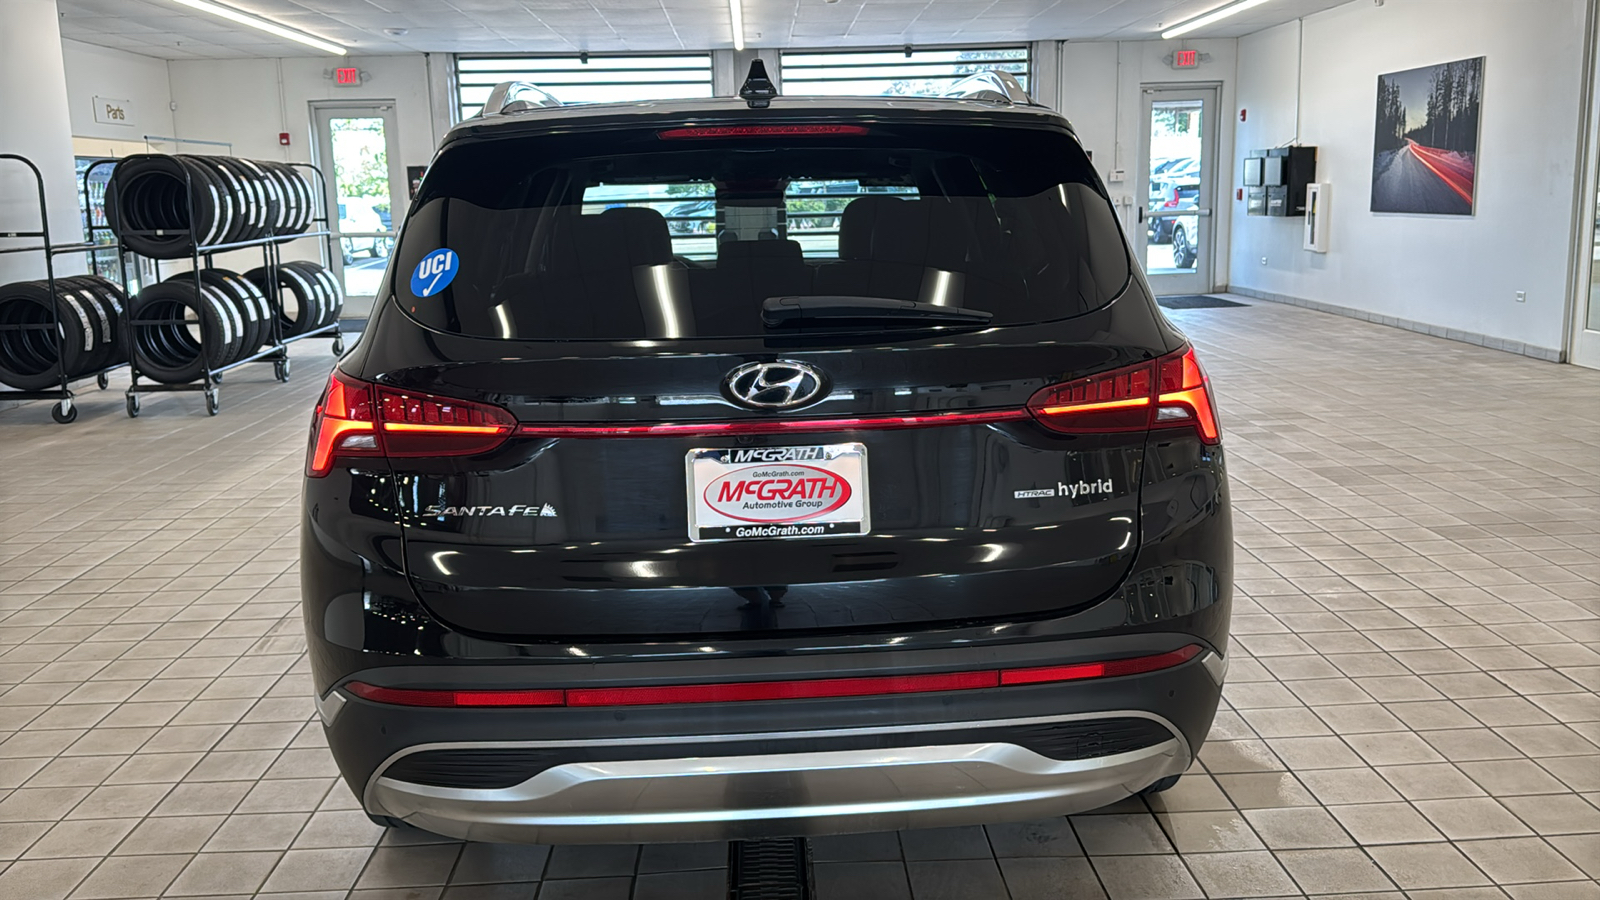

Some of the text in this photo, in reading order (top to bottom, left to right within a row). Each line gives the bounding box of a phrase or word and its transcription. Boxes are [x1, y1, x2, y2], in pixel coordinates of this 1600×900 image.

[1177, 50, 1196, 66] EXIT
[337, 67, 356, 84] EXIT
[418, 251, 452, 280] UCI
[752, 470, 805, 478] GoMcGrath.com
[1017, 478, 1113, 499] HTRAC hybrid
[742, 500, 823, 510] Automotive Group
[735, 524, 825, 538] GoMcGrath.com
